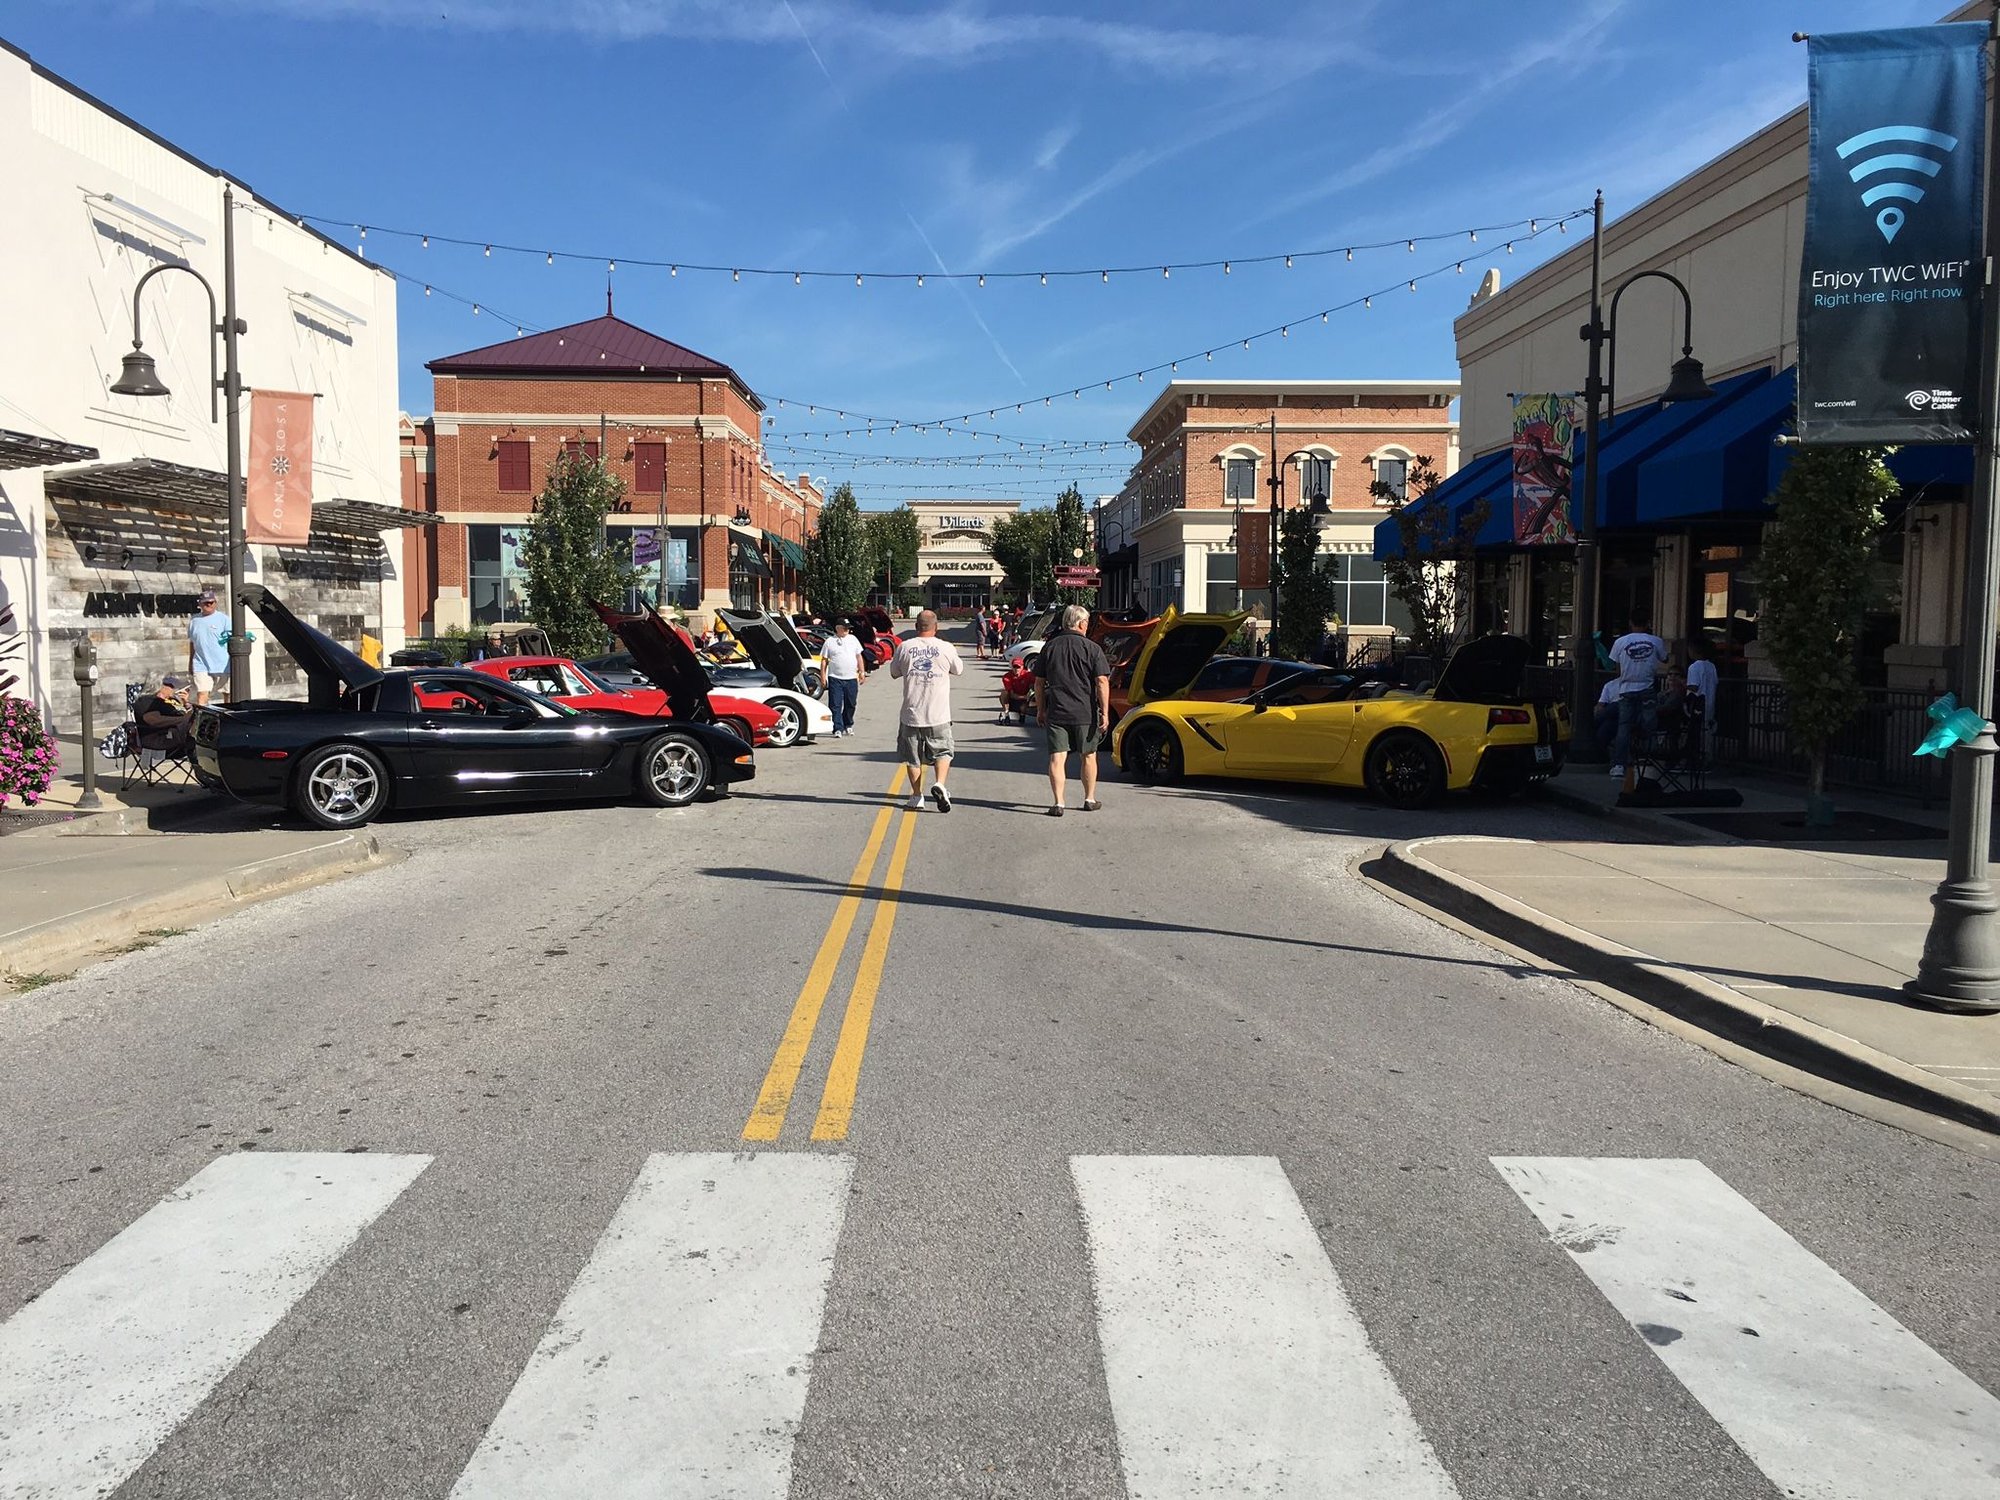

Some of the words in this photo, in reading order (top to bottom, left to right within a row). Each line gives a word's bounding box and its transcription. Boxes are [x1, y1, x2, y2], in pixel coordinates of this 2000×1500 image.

[1812, 270, 1864, 290] Enjoy
[1868, 265, 1916, 284] TWC
[1814, 293, 1850, 308] Right
[1853, 291, 1888, 303] here.
[1891, 288, 1929, 303] Right
[1932, 287, 1963, 299] now
[1931, 389, 1953, 397] Time
[1814, 400, 1857, 408] twc.com/wifi
[275, 403, 288, 452] ROSA
[271, 479, 285, 530] ZONA
[926, 562, 960, 571] YANKEE
[961, 562, 994, 571] CANDLE
